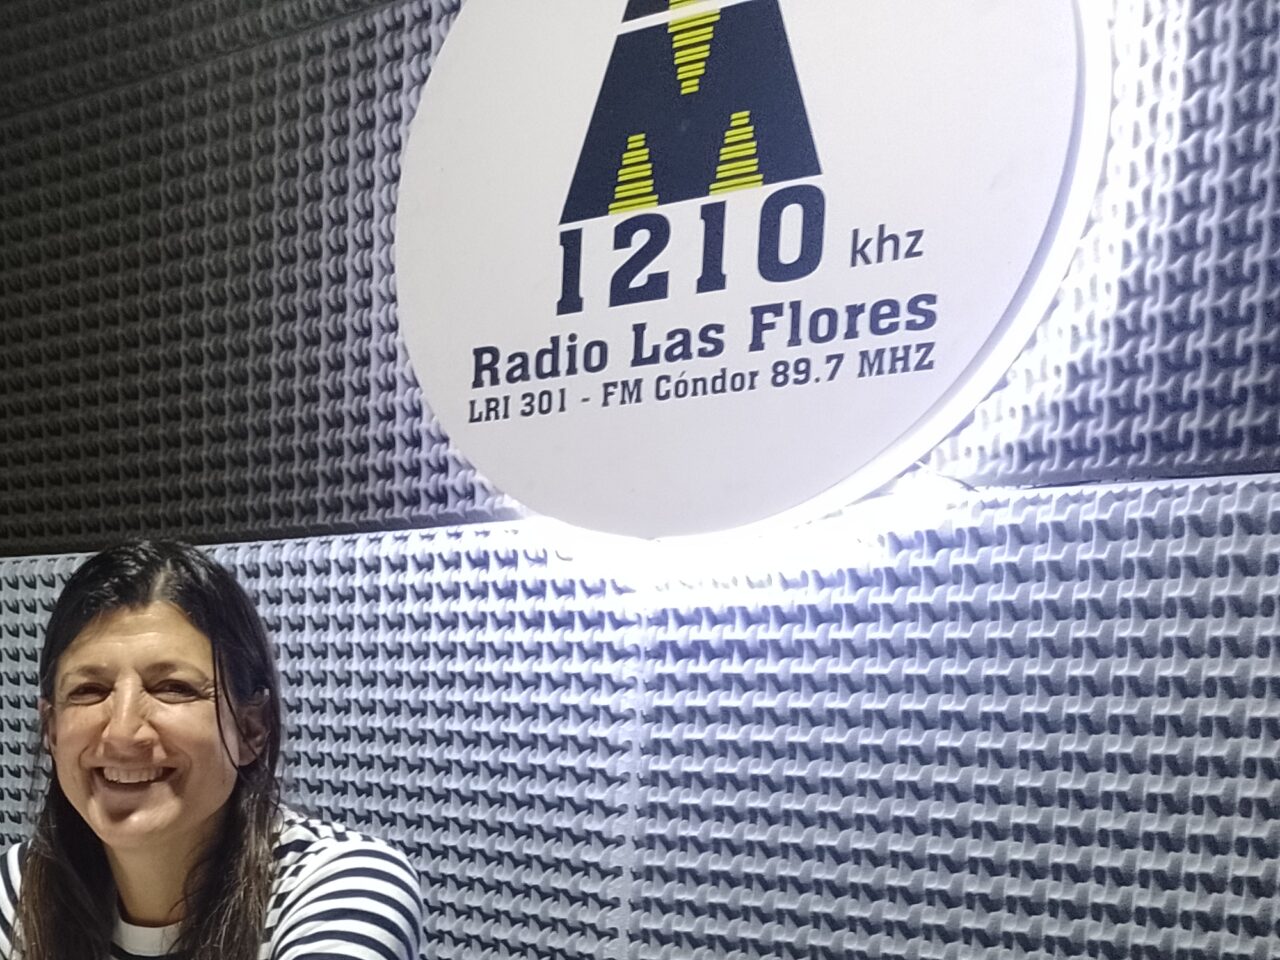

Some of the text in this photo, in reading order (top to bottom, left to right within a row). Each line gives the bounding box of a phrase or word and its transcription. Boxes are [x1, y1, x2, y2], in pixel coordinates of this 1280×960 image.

[556, 184, 925, 316] 1210 khz
[471, 292, 939, 389] Radio Las Flores
[602, 379, 644, 408] FM
[654, 368, 760, 402] Cóndor
[770, 350, 846, 388] 89.7
[858, 341, 936, 379] MHZ
